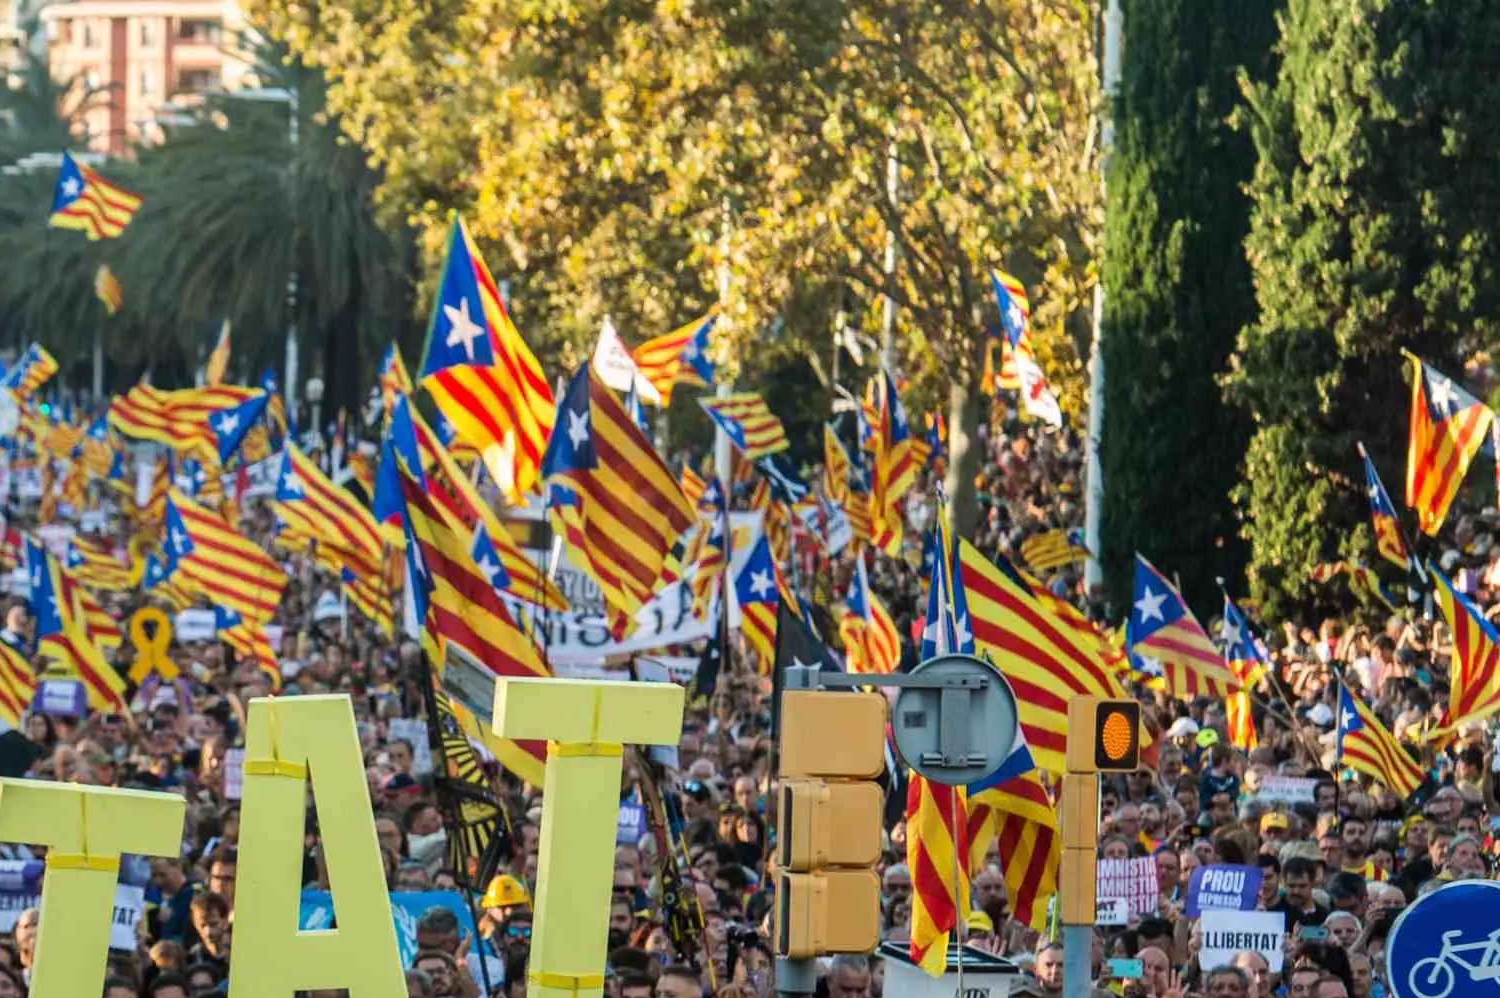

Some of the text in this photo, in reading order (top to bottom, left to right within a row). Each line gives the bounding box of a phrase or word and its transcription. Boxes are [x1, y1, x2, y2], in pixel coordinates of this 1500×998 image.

[1096, 856, 1158, 877] MNISTIA
[1096, 878, 1159, 896] MNISTIA
[1201, 869, 1246, 892] PROU
[1205, 931, 1278, 951] LLIBERTAT
